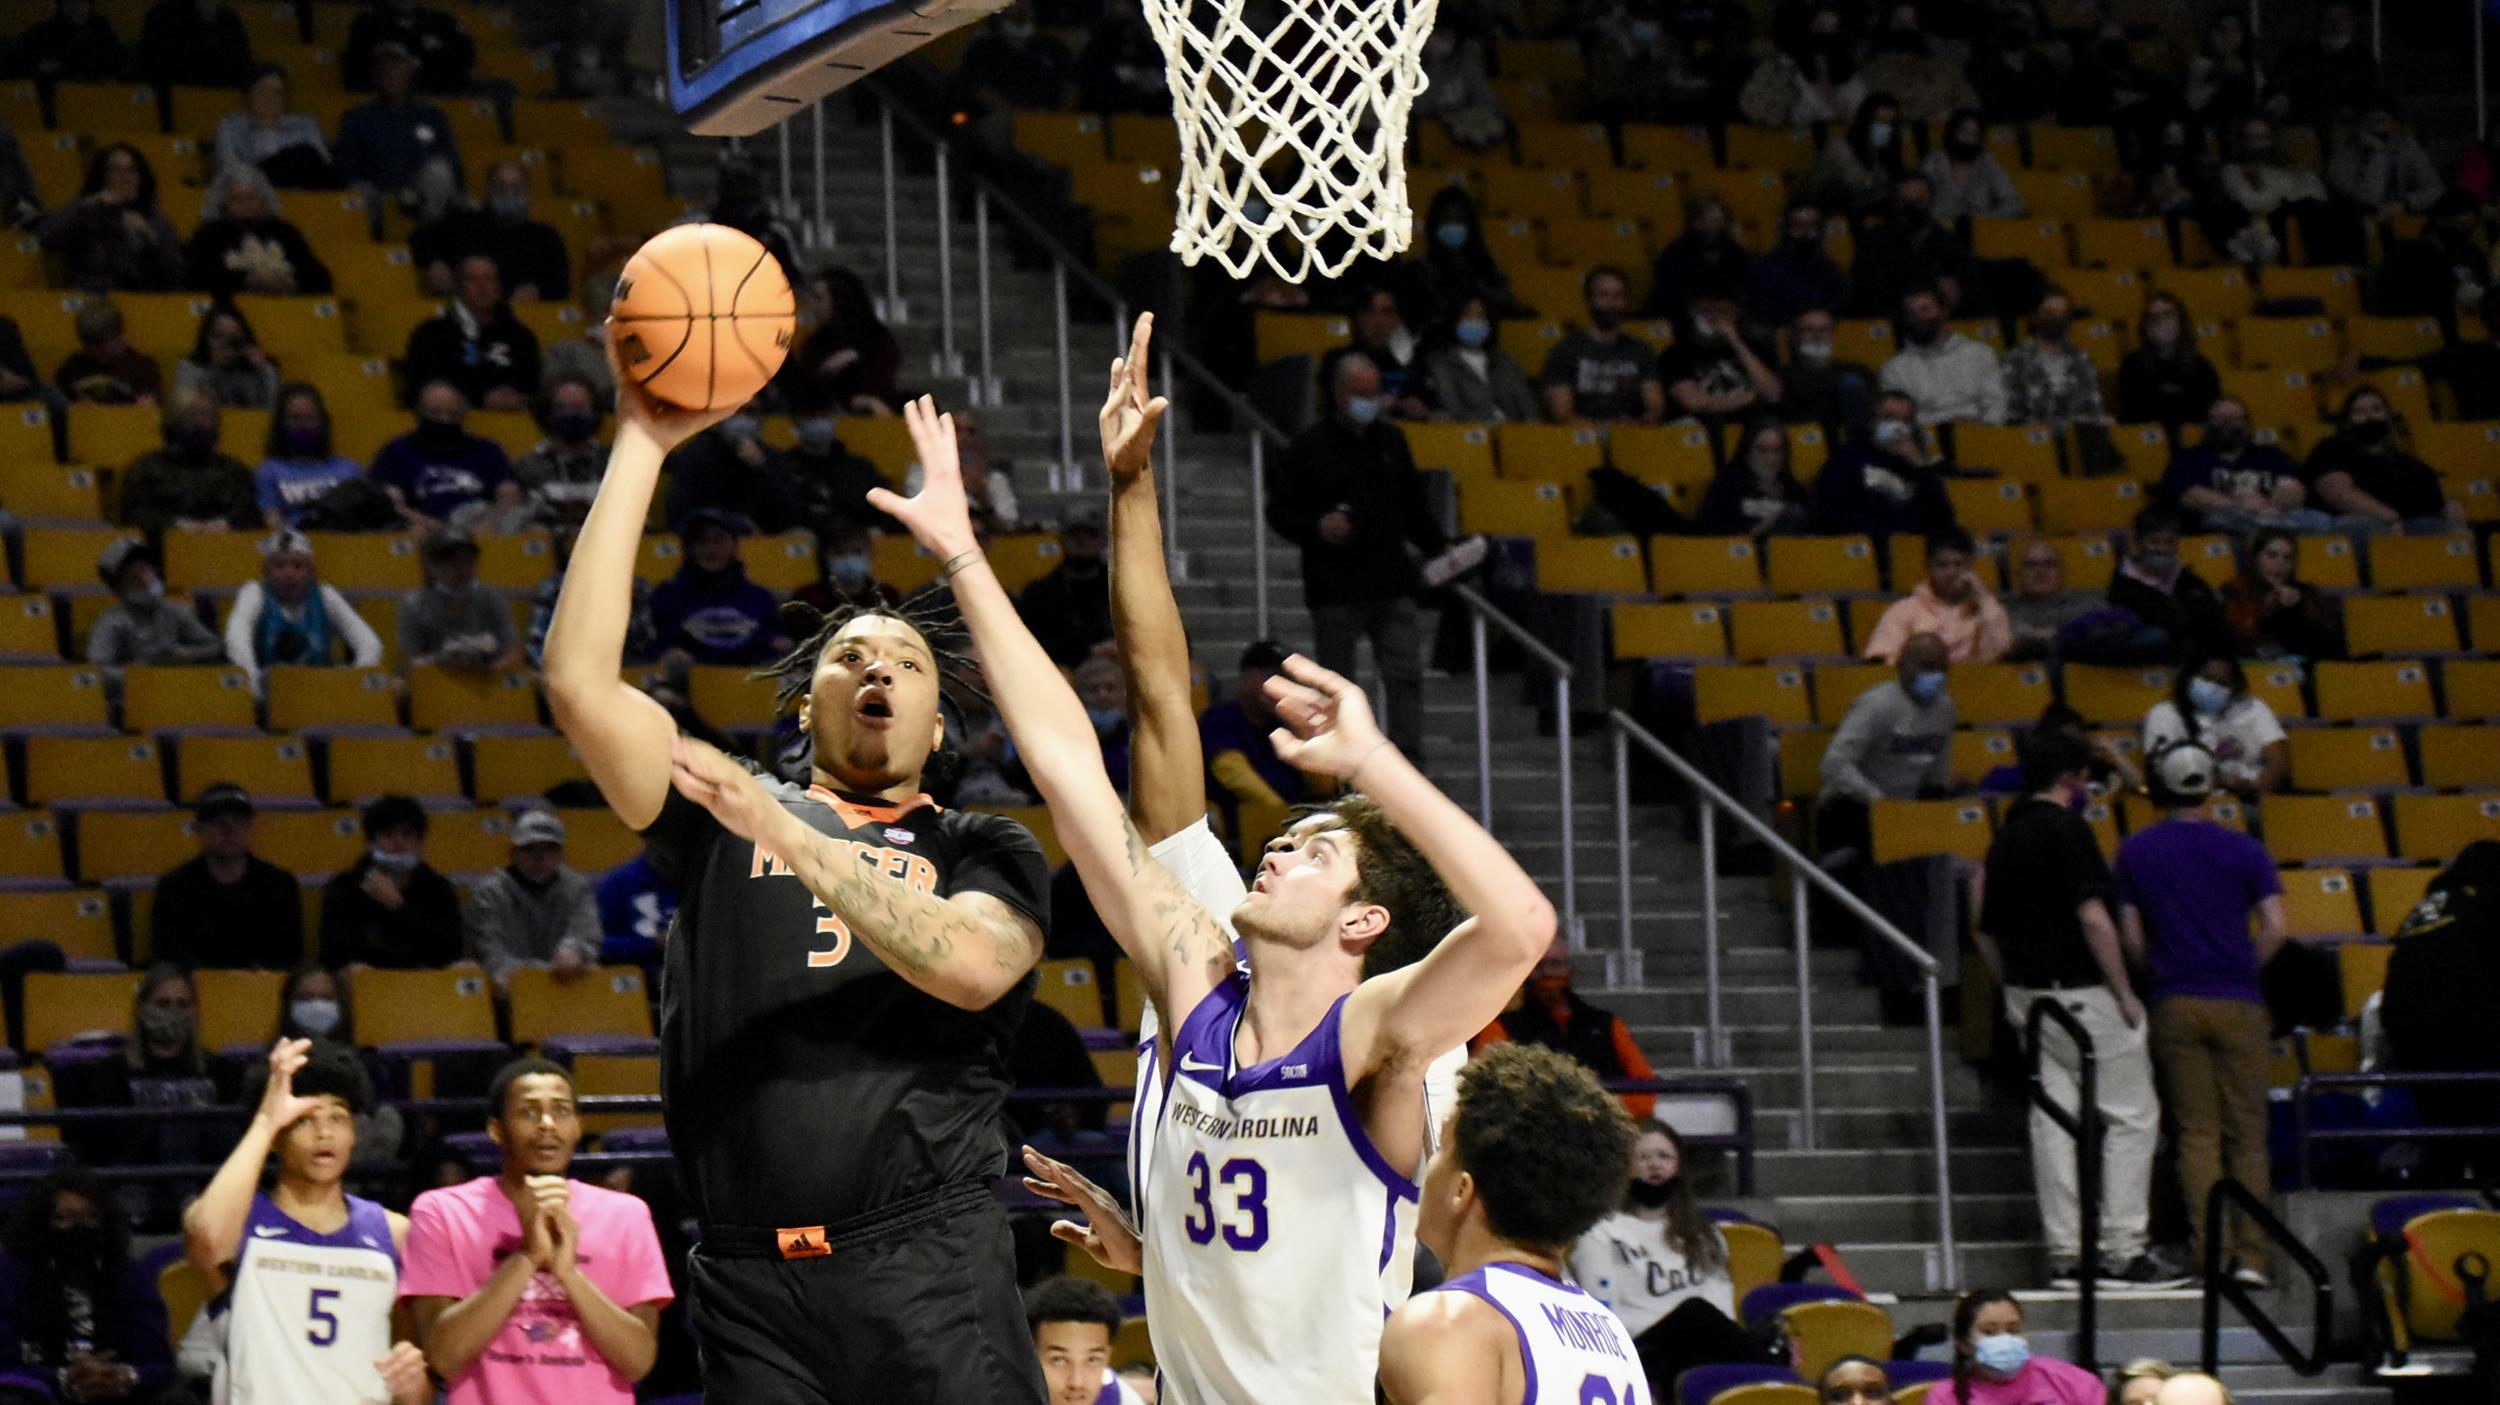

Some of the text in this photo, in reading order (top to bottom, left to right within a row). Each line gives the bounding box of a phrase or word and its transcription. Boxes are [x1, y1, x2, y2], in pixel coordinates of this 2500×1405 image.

[750, 838, 938, 895] MCER
[1171, 1101, 1232, 1140] WESTERN
[1185, 1149, 1270, 1253] 33
[306, 1287, 342, 1347] 5
[1540, 1302, 1628, 1362] MONROE
